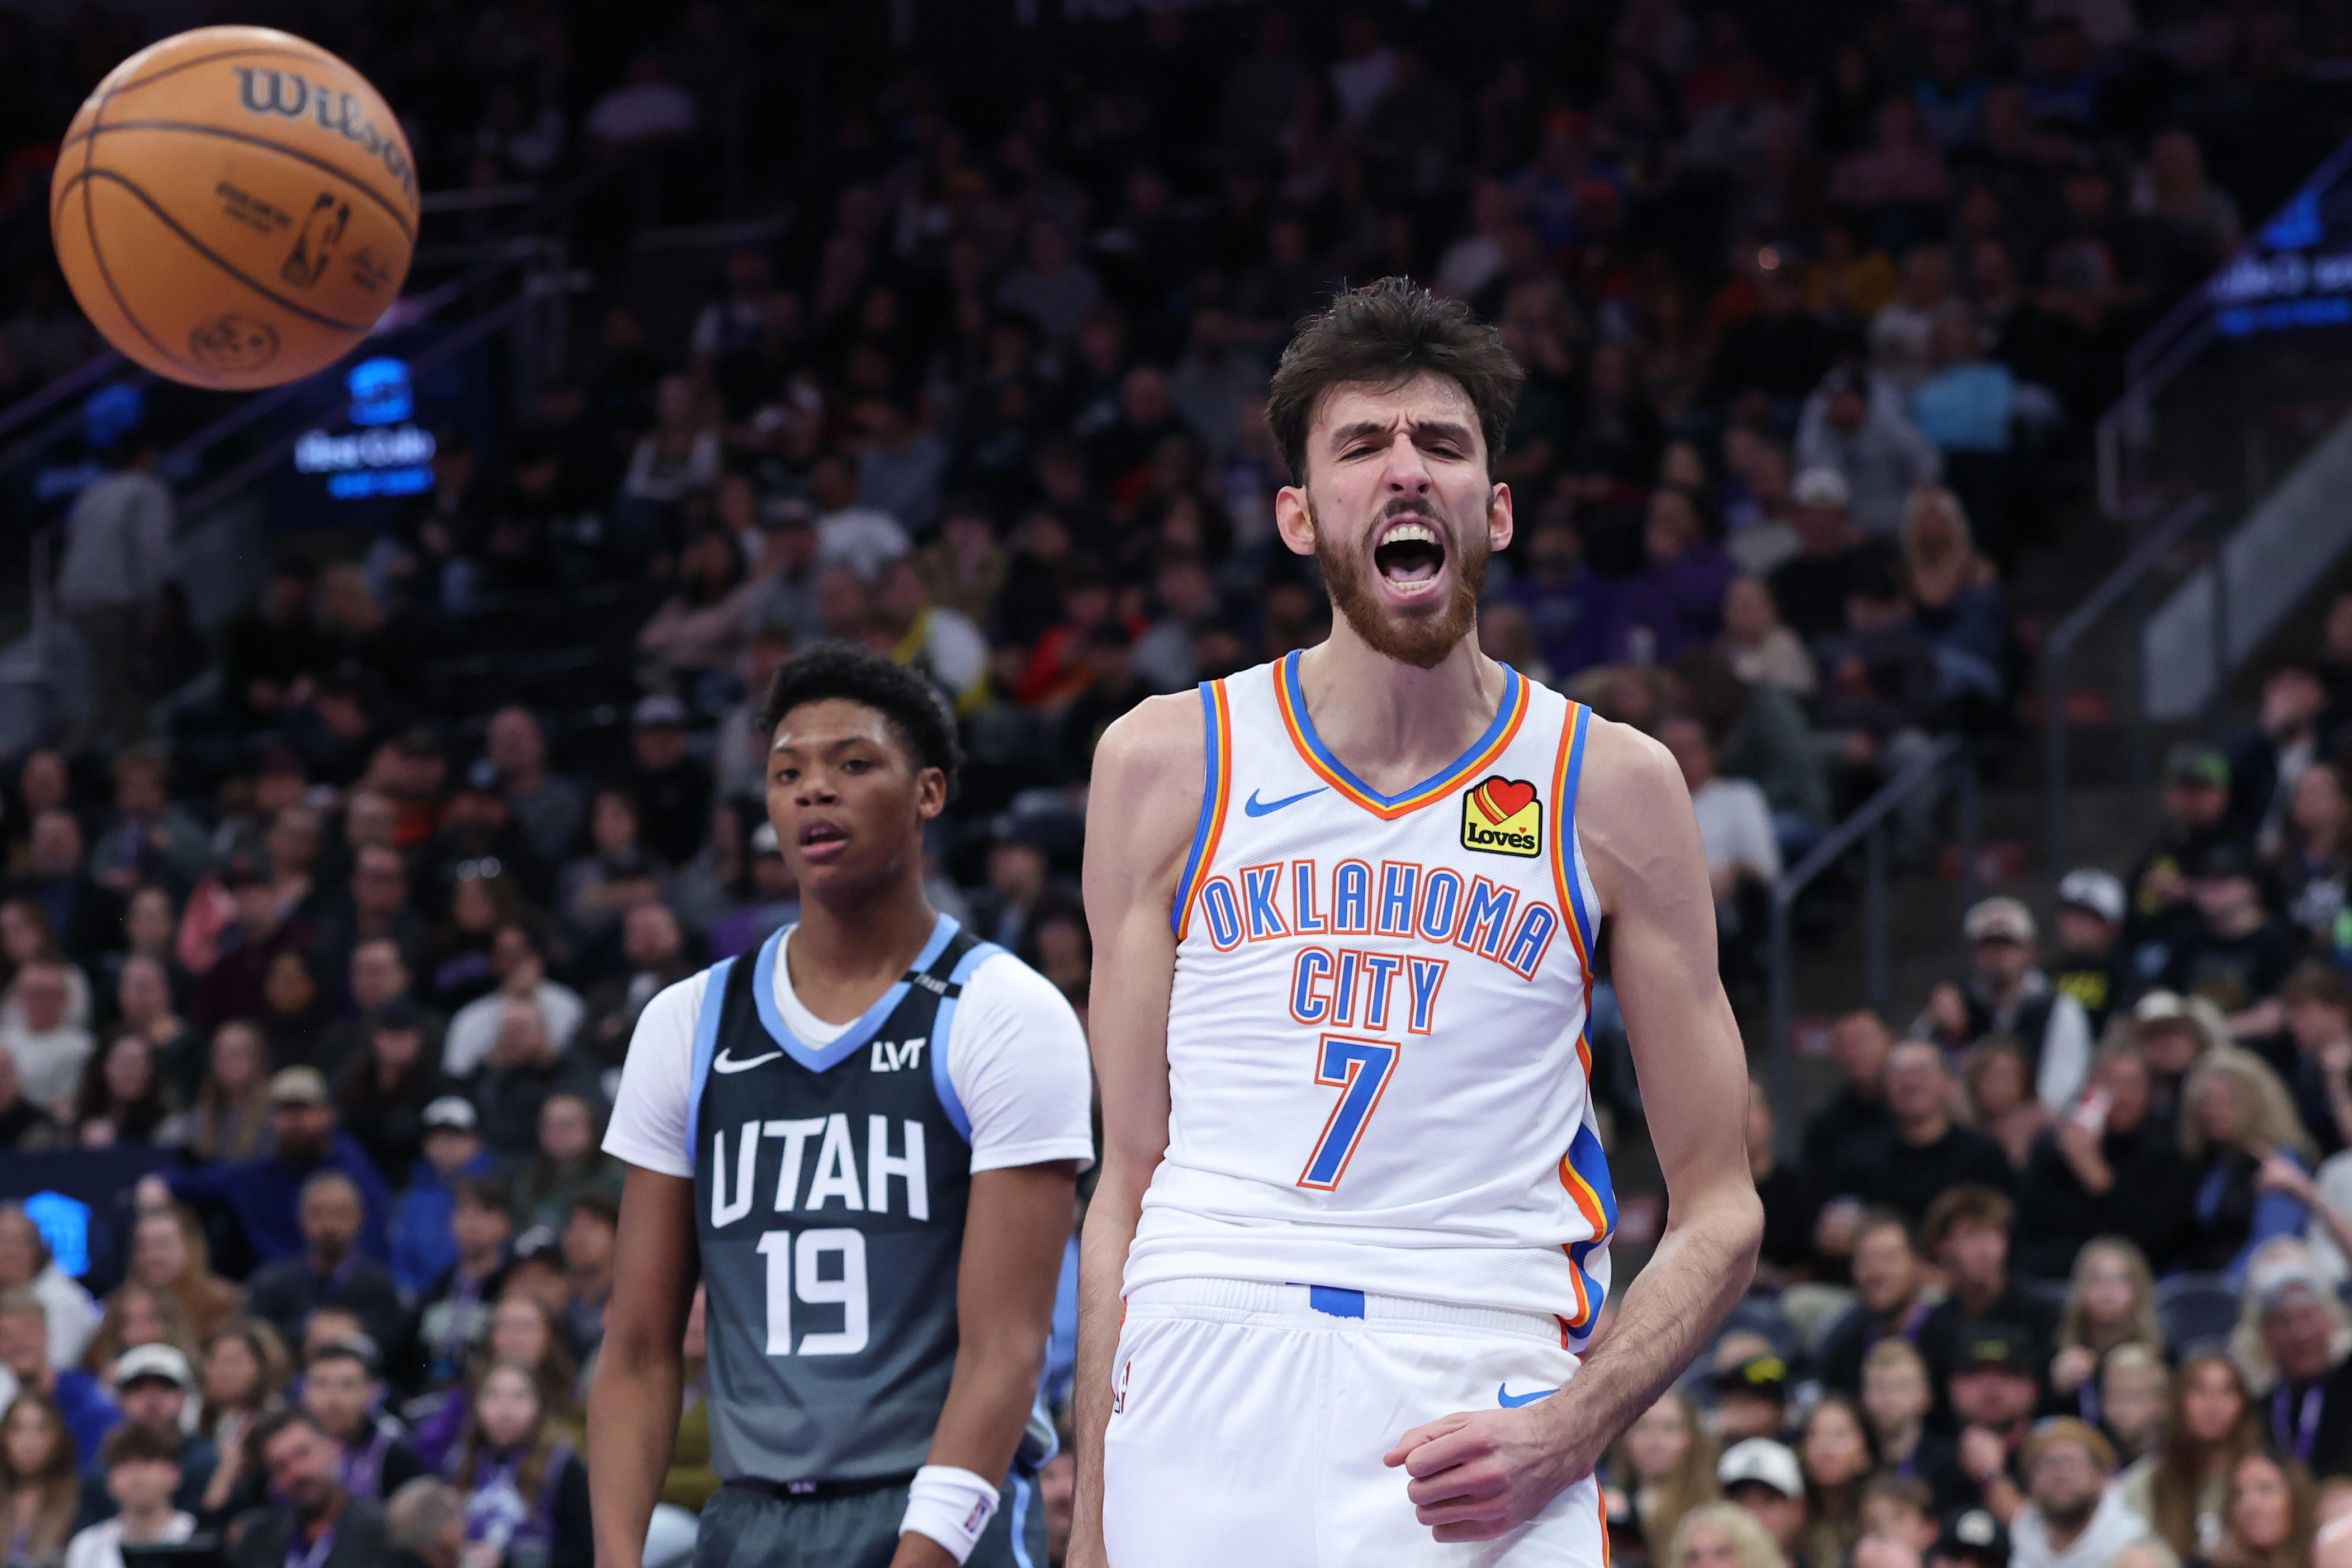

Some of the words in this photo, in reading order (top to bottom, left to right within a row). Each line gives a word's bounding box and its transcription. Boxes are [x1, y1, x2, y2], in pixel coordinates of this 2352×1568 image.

[1200, 858, 1559, 982] OKLAHOMA
[1289, 946, 1449, 1035] CITY
[870, 1036, 927, 1072] LVT
[1296, 1032, 1401, 1191] 7
[711, 1112, 930, 1229] UTAH
[755, 1228, 869, 1356] 19
